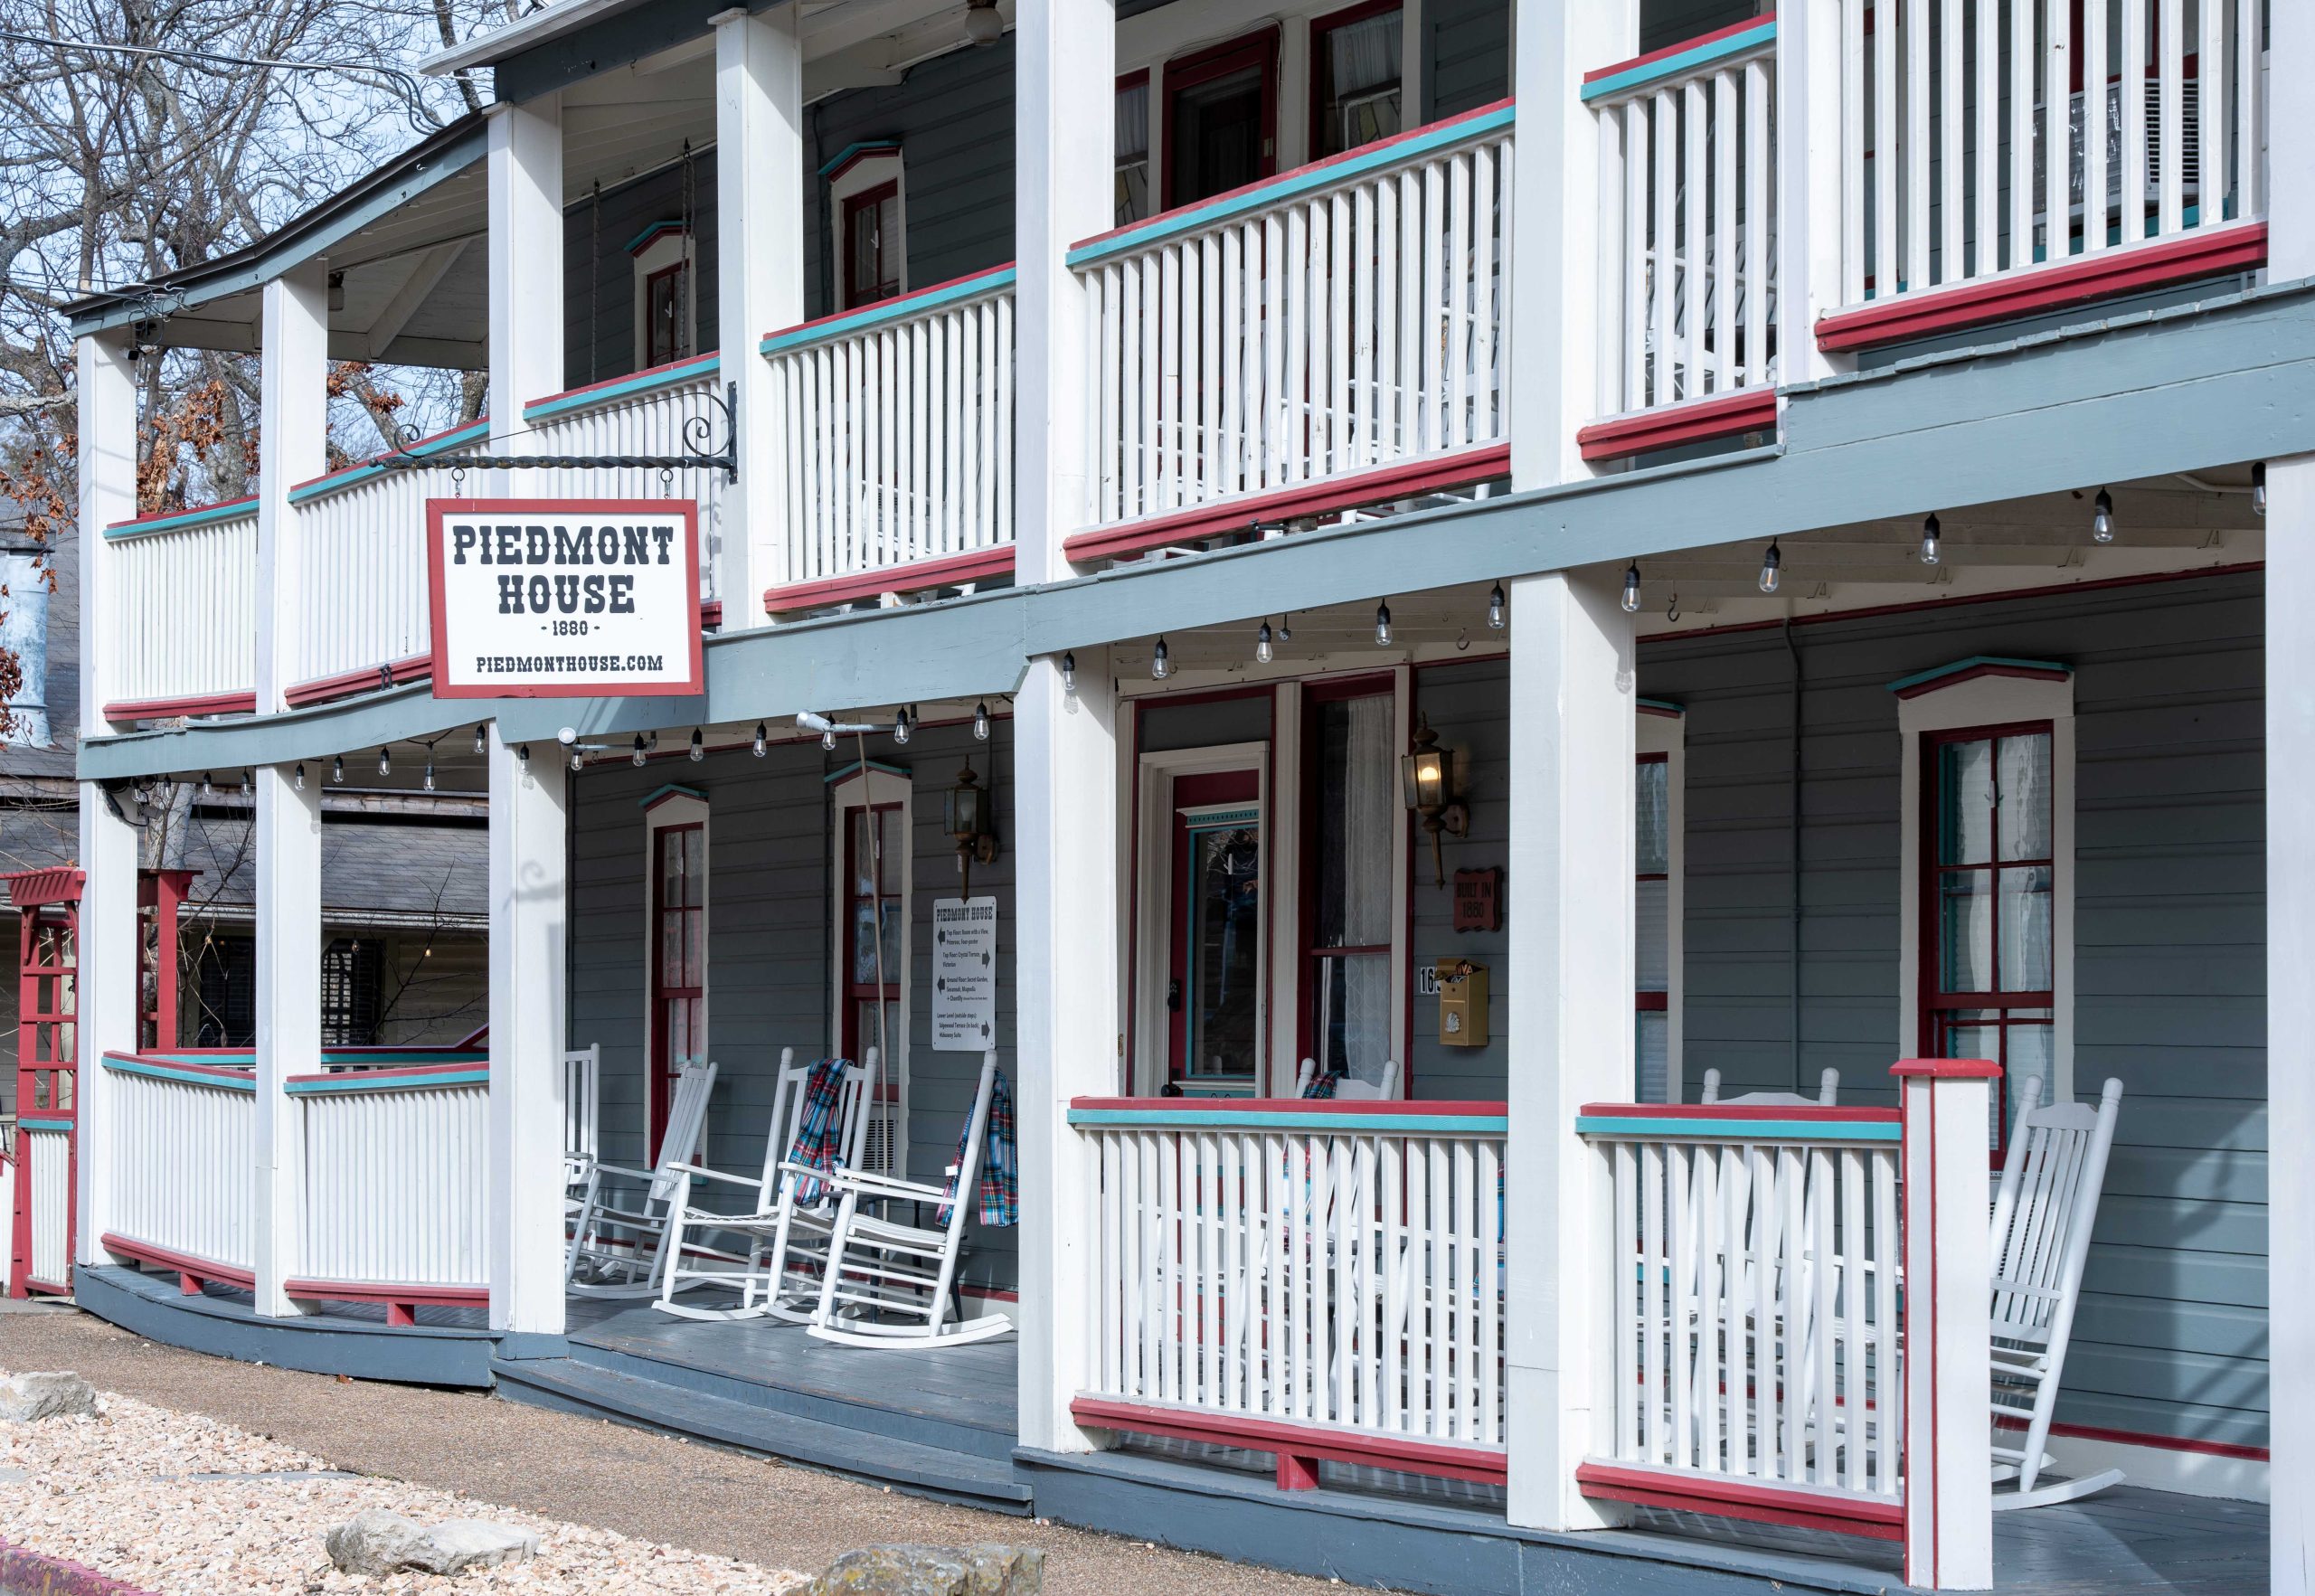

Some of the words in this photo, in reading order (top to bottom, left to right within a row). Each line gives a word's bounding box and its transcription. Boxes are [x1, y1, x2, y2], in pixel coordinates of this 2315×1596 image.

[452, 525, 674, 565] PIEDMONT
[497, 574, 635, 614] HOUSE
[477, 656, 663, 673] PIEDMONTHOUSE.COM
[1457, 882, 1477, 898] BUILT
[1481, 882, 1491, 898] IN
[937, 907, 970, 922] PIEDMONT
[971, 906, 993, 921] HOUSE
[1462, 902, 1484, 919] 1880
